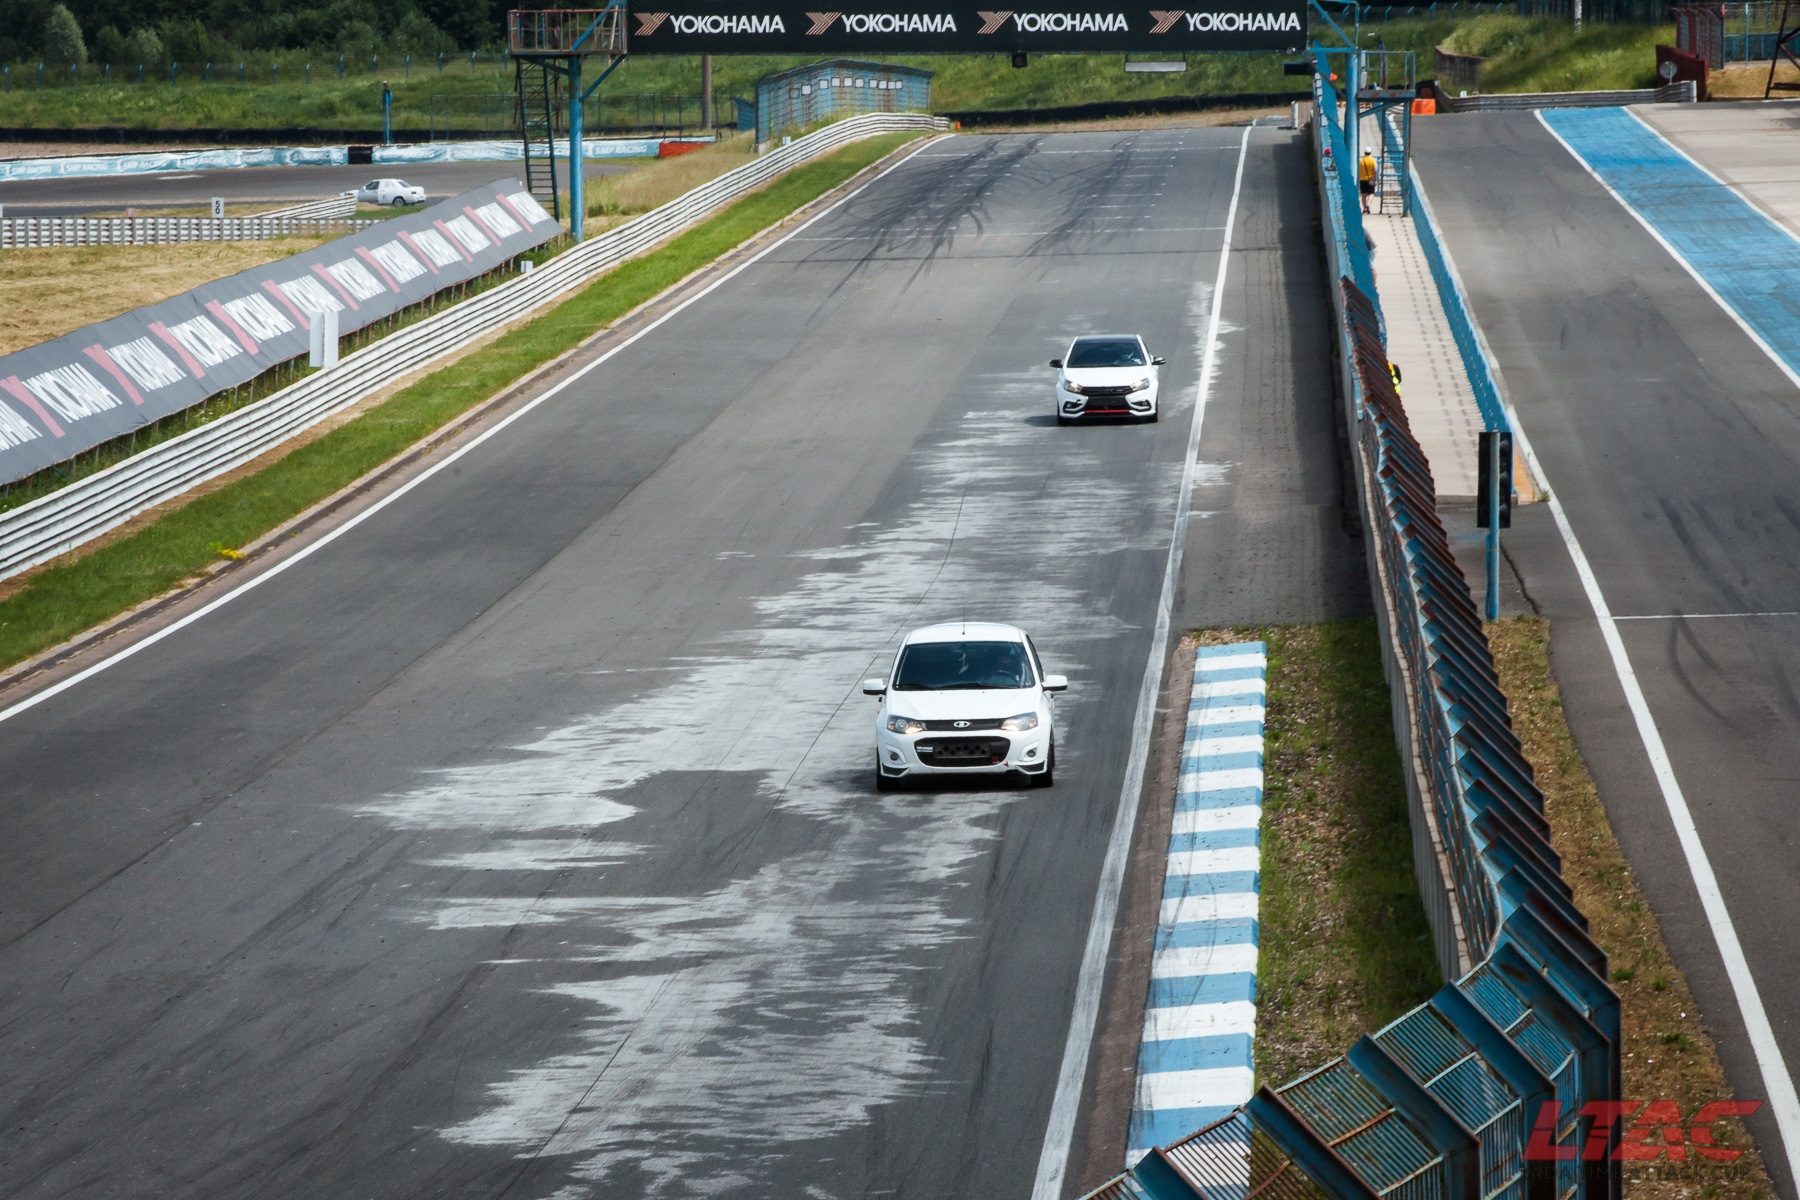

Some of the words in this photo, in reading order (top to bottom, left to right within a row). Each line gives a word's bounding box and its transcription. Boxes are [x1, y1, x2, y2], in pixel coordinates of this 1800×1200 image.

[670, 15, 785, 34] YOKOHAMA
[841, 14, 957, 33] YOKOHAMA
[1013, 13, 1129, 32] YOKOHAMA
[1186, 12, 1301, 31] YOKOHAMA
[615, 146, 647, 154] RACING
[105, 336, 187, 393] YOKOHAMA
[21, 362, 123, 424] YOKOHAMA
